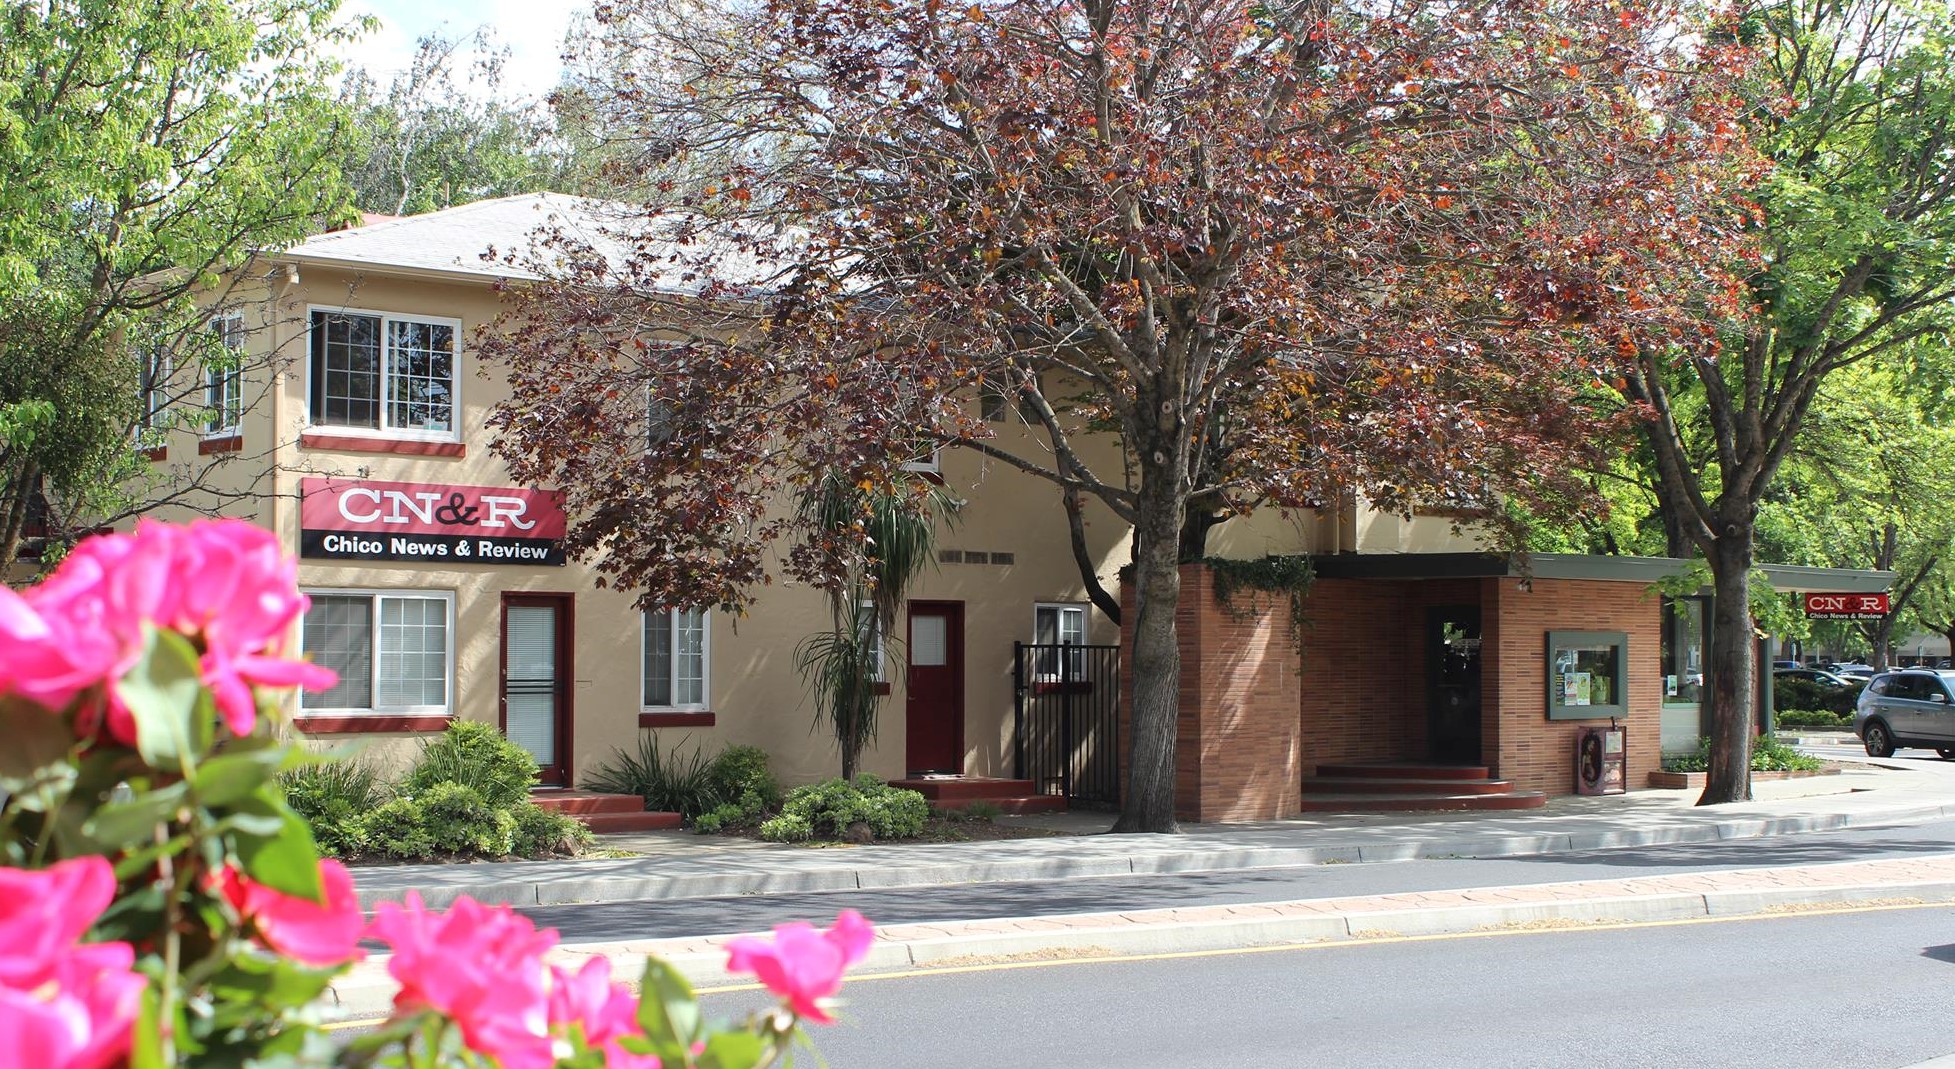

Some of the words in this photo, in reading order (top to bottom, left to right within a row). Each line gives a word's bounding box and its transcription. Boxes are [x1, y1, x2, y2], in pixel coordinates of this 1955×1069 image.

[337, 487, 536, 531] CN&R
[323, 535, 383, 555] Chico
[391, 538, 448, 556] News
[455, 540, 471, 557] &
[479, 541, 549, 560] Review
[1809, 596, 1882, 610] CN&R
